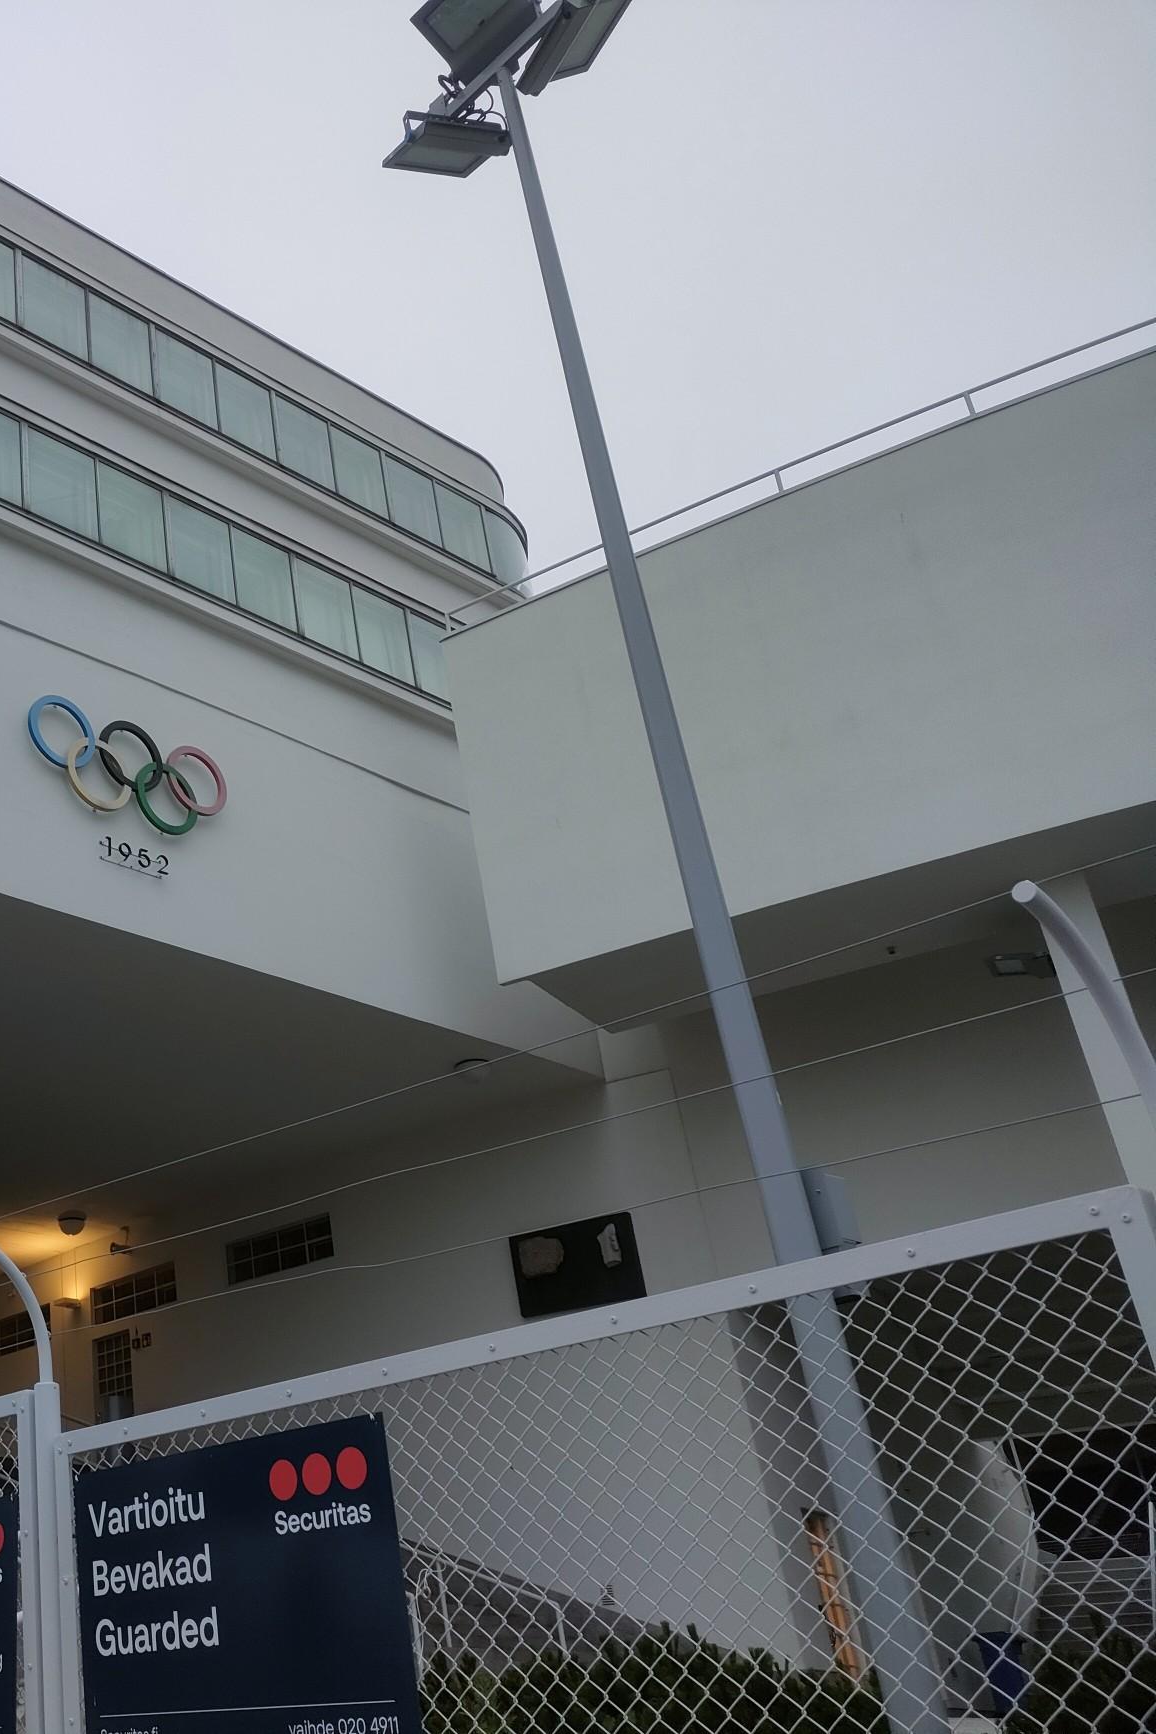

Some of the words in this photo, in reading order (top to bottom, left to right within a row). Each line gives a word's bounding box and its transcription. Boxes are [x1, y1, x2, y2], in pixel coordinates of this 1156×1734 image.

[105, 836, 169, 876] 1952
[88, 1487, 205, 1537] Vartioitu
[275, 1502, 371, 1535] Securitas
[93, 1543, 211, 1596] Bevakad
[96, 1606, 219, 1656] Guarded
[338, 1718, 366, 1734] 020
[371, 1716, 399, 1734] 4911
